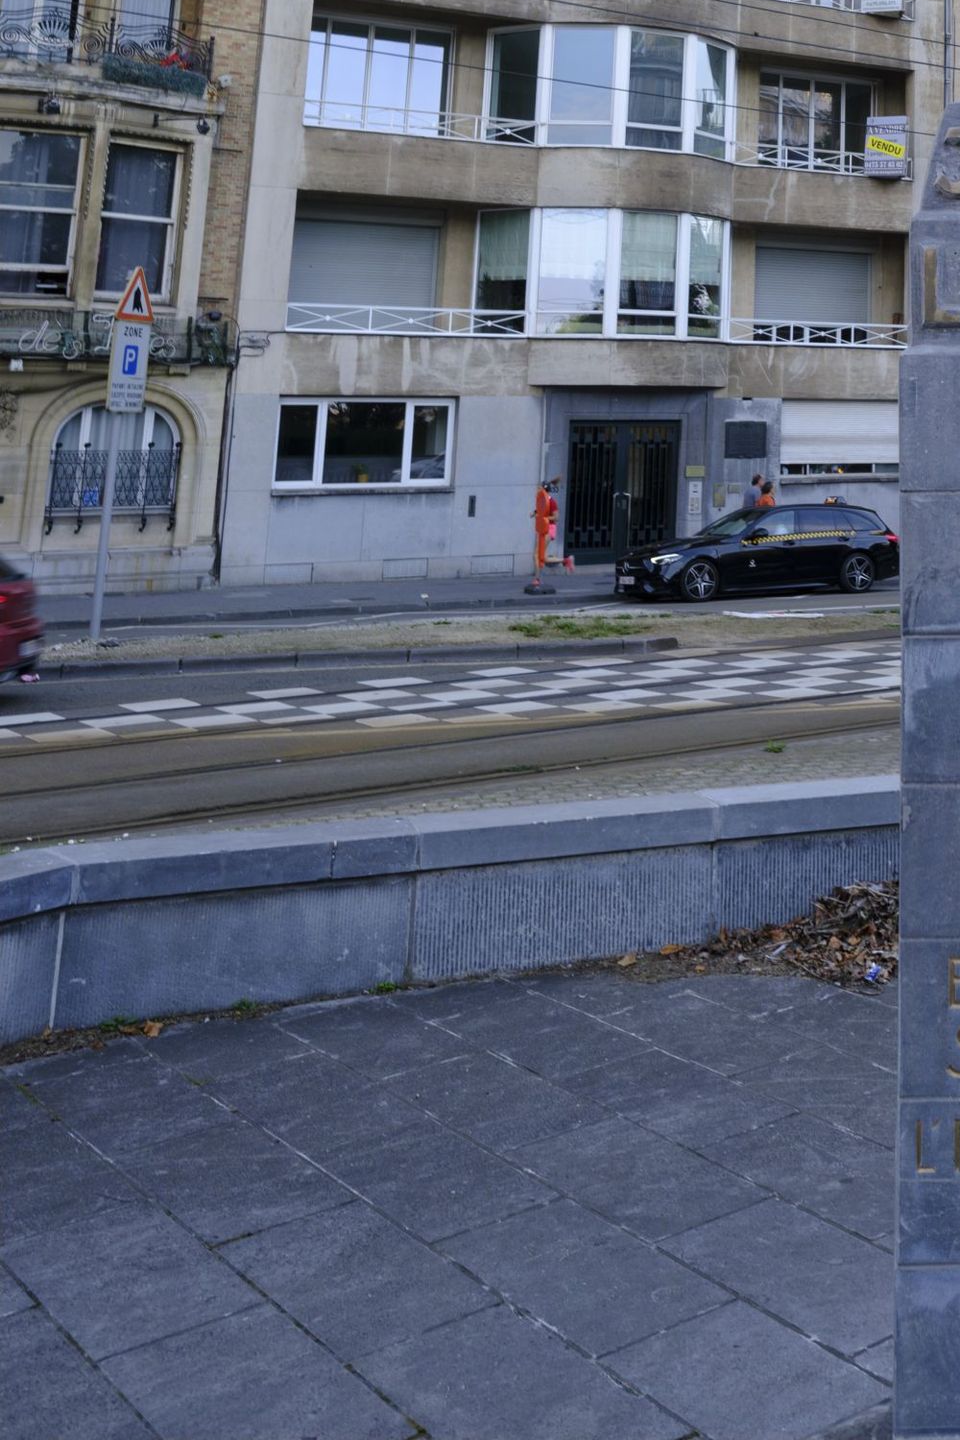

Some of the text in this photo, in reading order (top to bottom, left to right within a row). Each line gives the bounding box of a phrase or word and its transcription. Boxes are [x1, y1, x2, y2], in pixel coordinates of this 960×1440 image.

[871, 139, 901, 155] VENDU
[124, 326, 143, 337] ZONE
[124, 348, 136, 372] P
